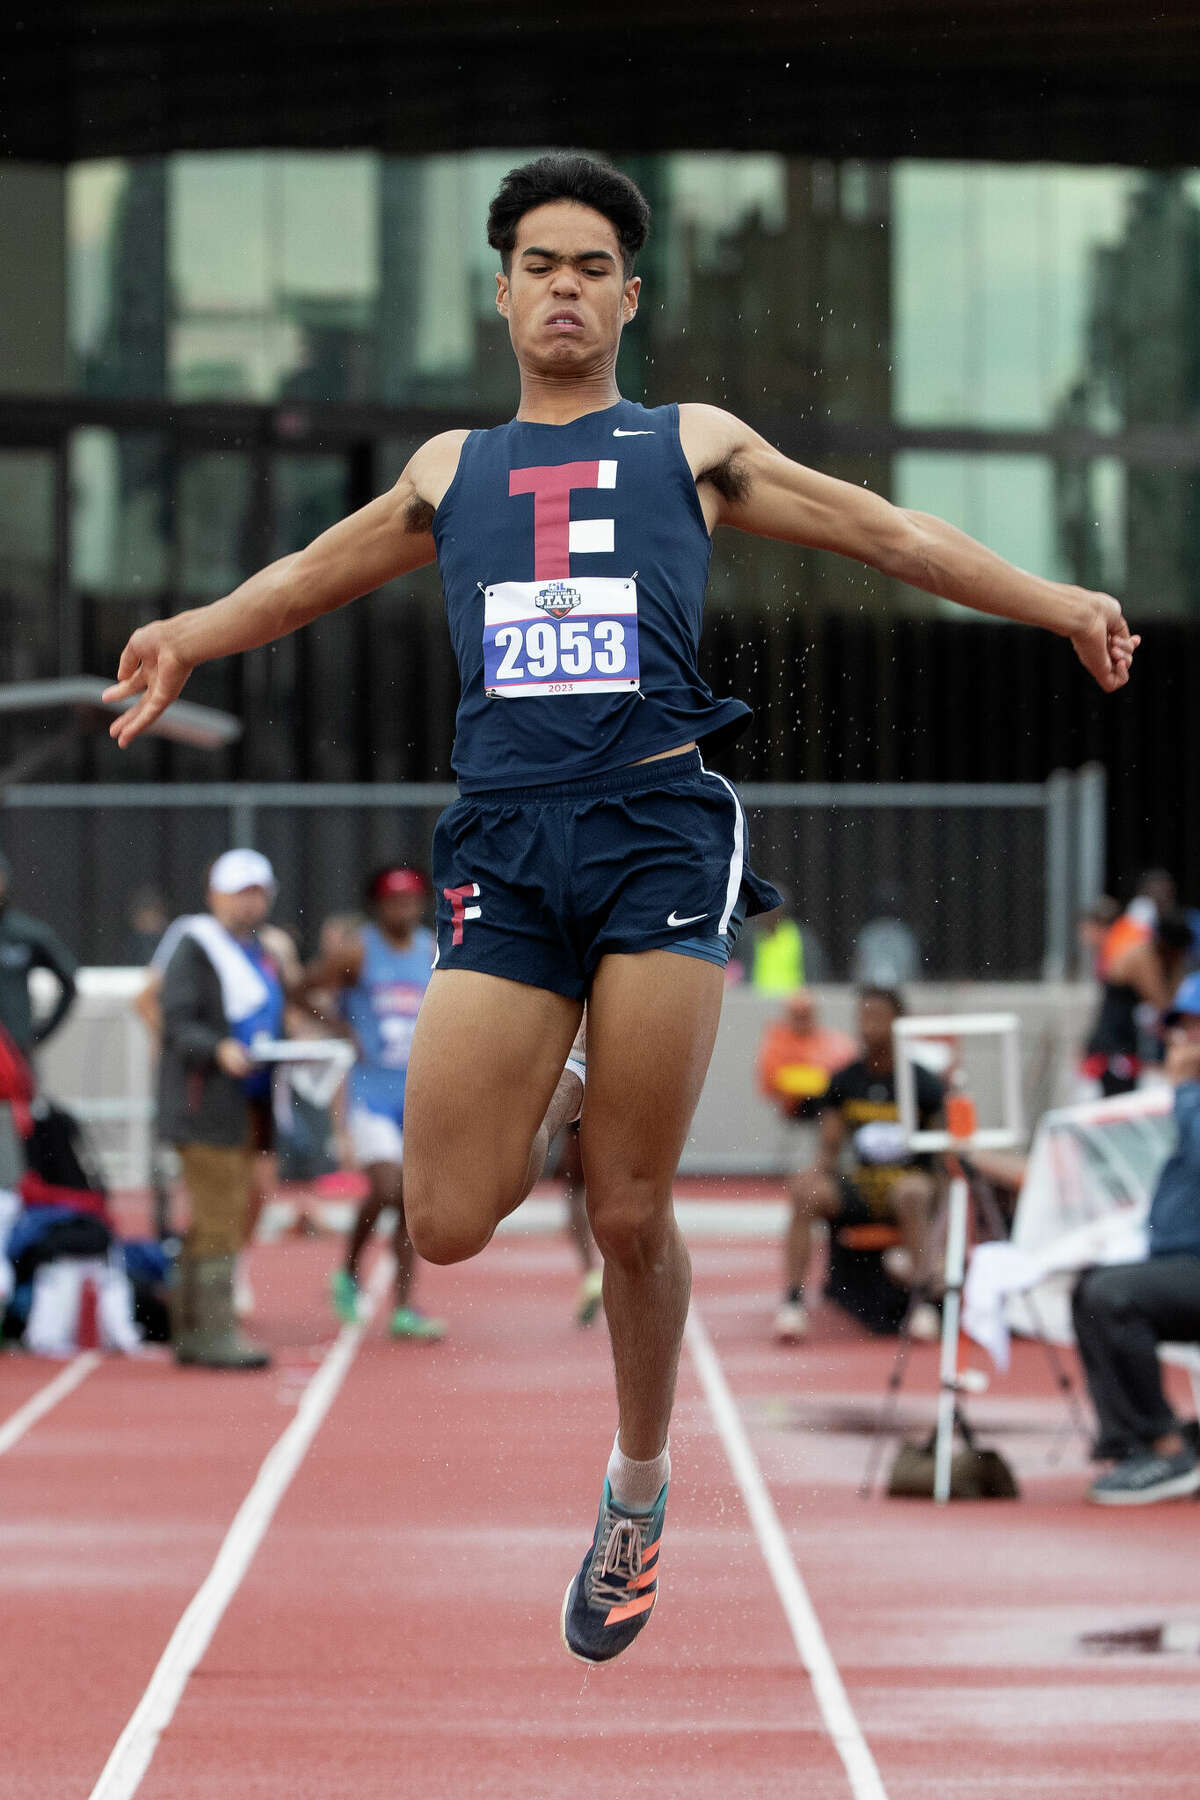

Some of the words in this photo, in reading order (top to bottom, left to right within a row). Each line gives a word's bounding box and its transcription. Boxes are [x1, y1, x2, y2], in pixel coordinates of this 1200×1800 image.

[535, 594, 581, 606] STATE
[494, 620, 627, 680] 2953
[548, 683, 574, 693] 2023
